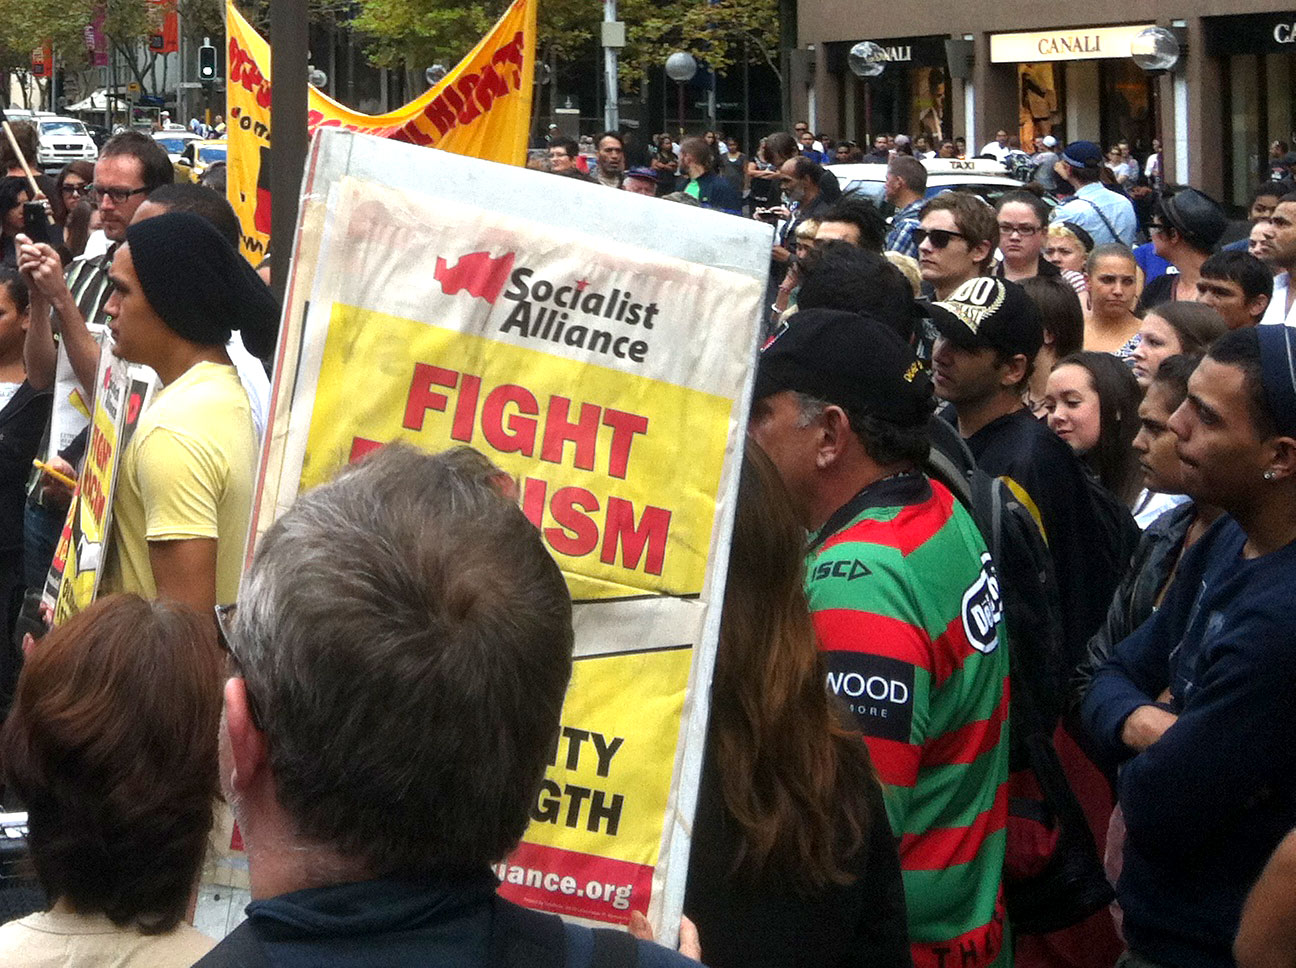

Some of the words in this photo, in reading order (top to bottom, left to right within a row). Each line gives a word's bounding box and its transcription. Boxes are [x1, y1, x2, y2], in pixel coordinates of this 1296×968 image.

[1038, 35, 1102, 55] CANALI
[949, 160, 975, 170] TAXI
[503, 267, 660, 331] Socialist
[499, 298, 649, 363] Alliance
[402, 362, 649, 480] FIGHT
[490, 472, 672, 577] ISM
[825, 671, 909, 704] WOOD
[530, 778, 625, 837] GTH
[491, 863, 633, 910] iance.org
